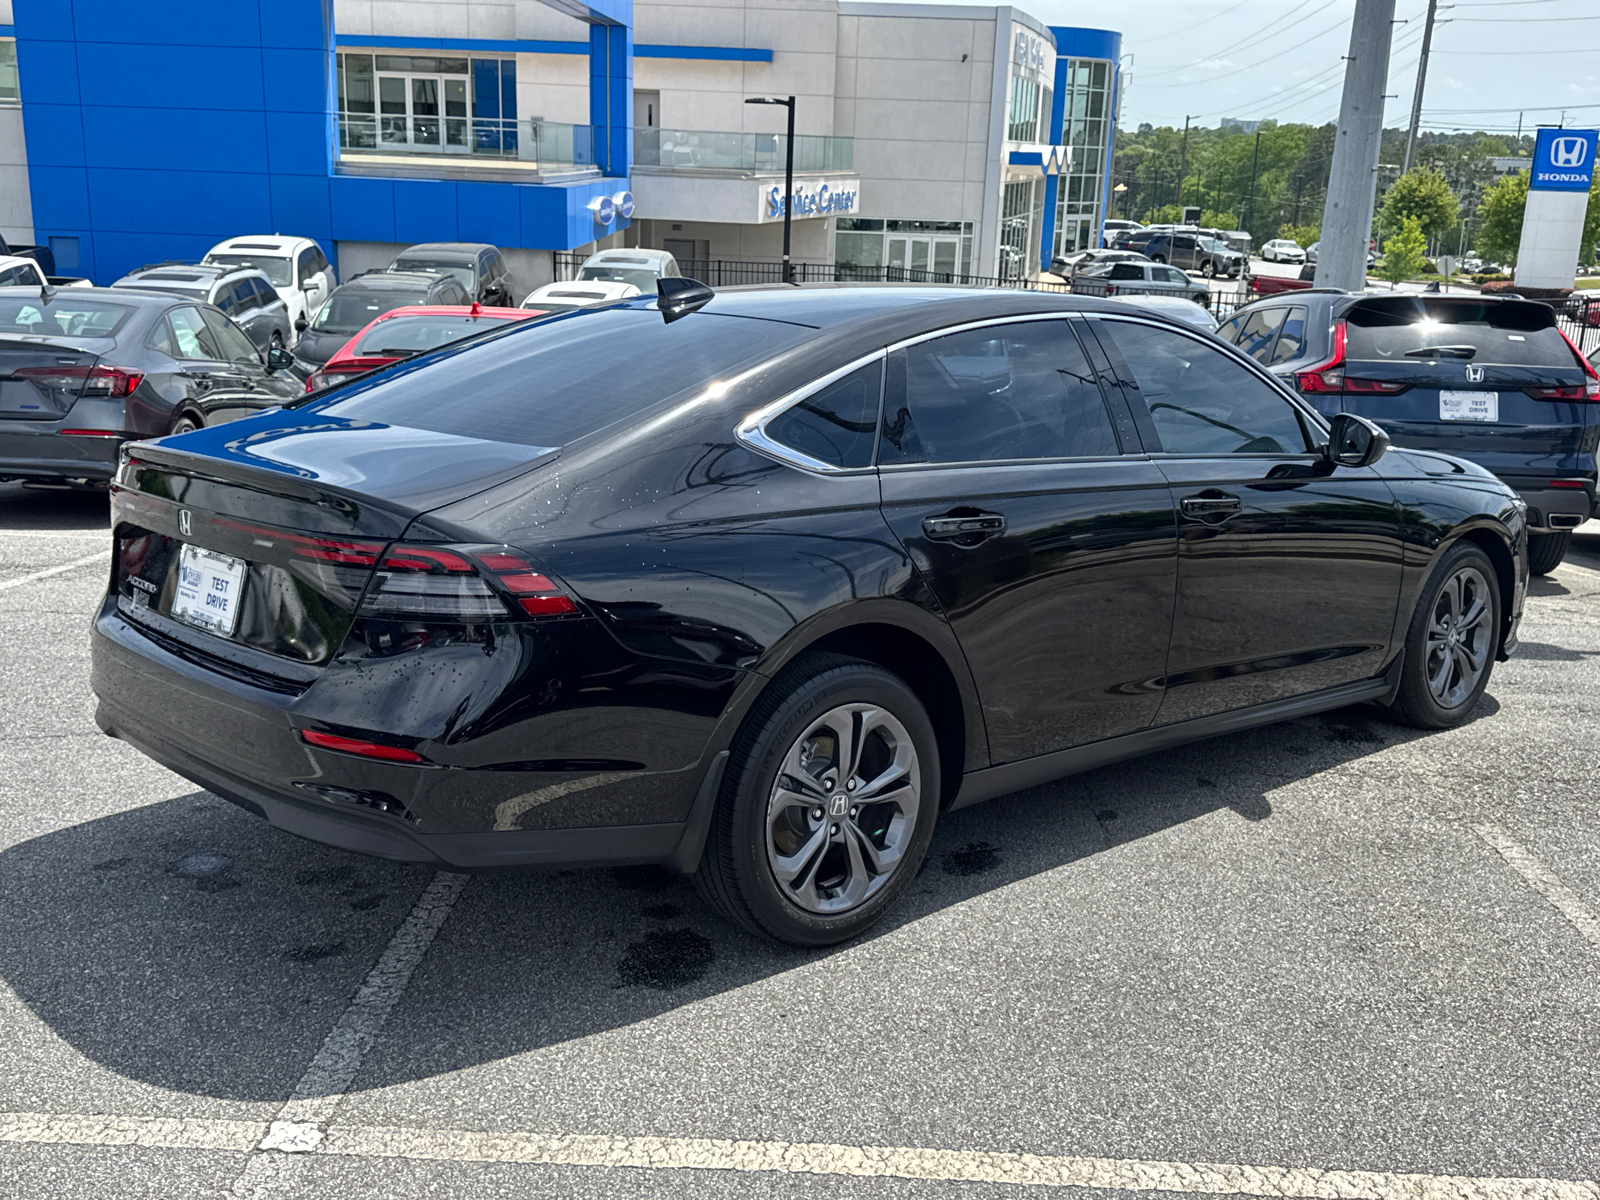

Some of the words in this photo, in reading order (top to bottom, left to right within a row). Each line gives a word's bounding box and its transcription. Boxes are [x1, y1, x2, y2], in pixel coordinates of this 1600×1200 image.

[1537, 173, 1589, 182] HONDA
[770, 186, 816, 217] Sevice
[820, 184, 856, 212] Center
[212, 576, 229, 593] TEST
[206, 592, 228, 612] DRIVE
